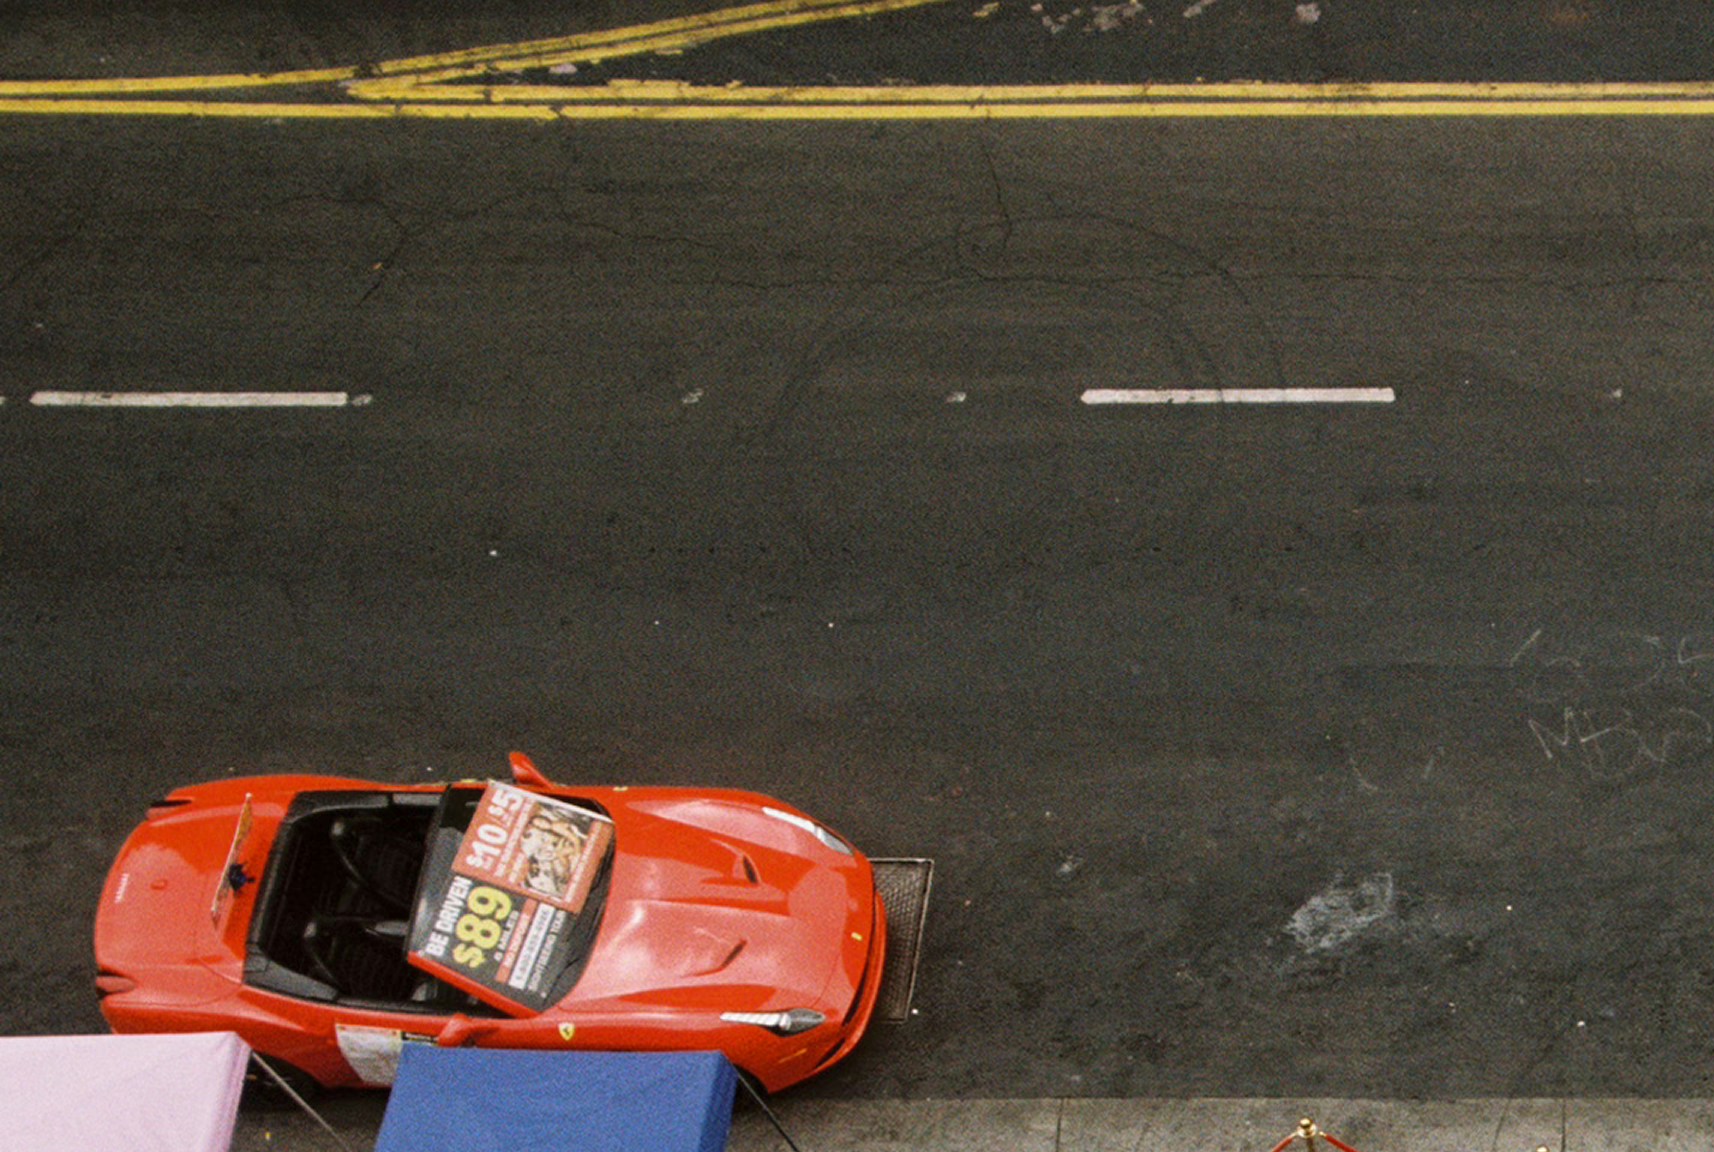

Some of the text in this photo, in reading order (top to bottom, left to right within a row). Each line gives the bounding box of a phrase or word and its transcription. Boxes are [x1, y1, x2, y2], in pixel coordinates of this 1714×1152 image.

[425, 876, 474, 957] BE DRIVEN
[453, 885, 512, 968] $89
